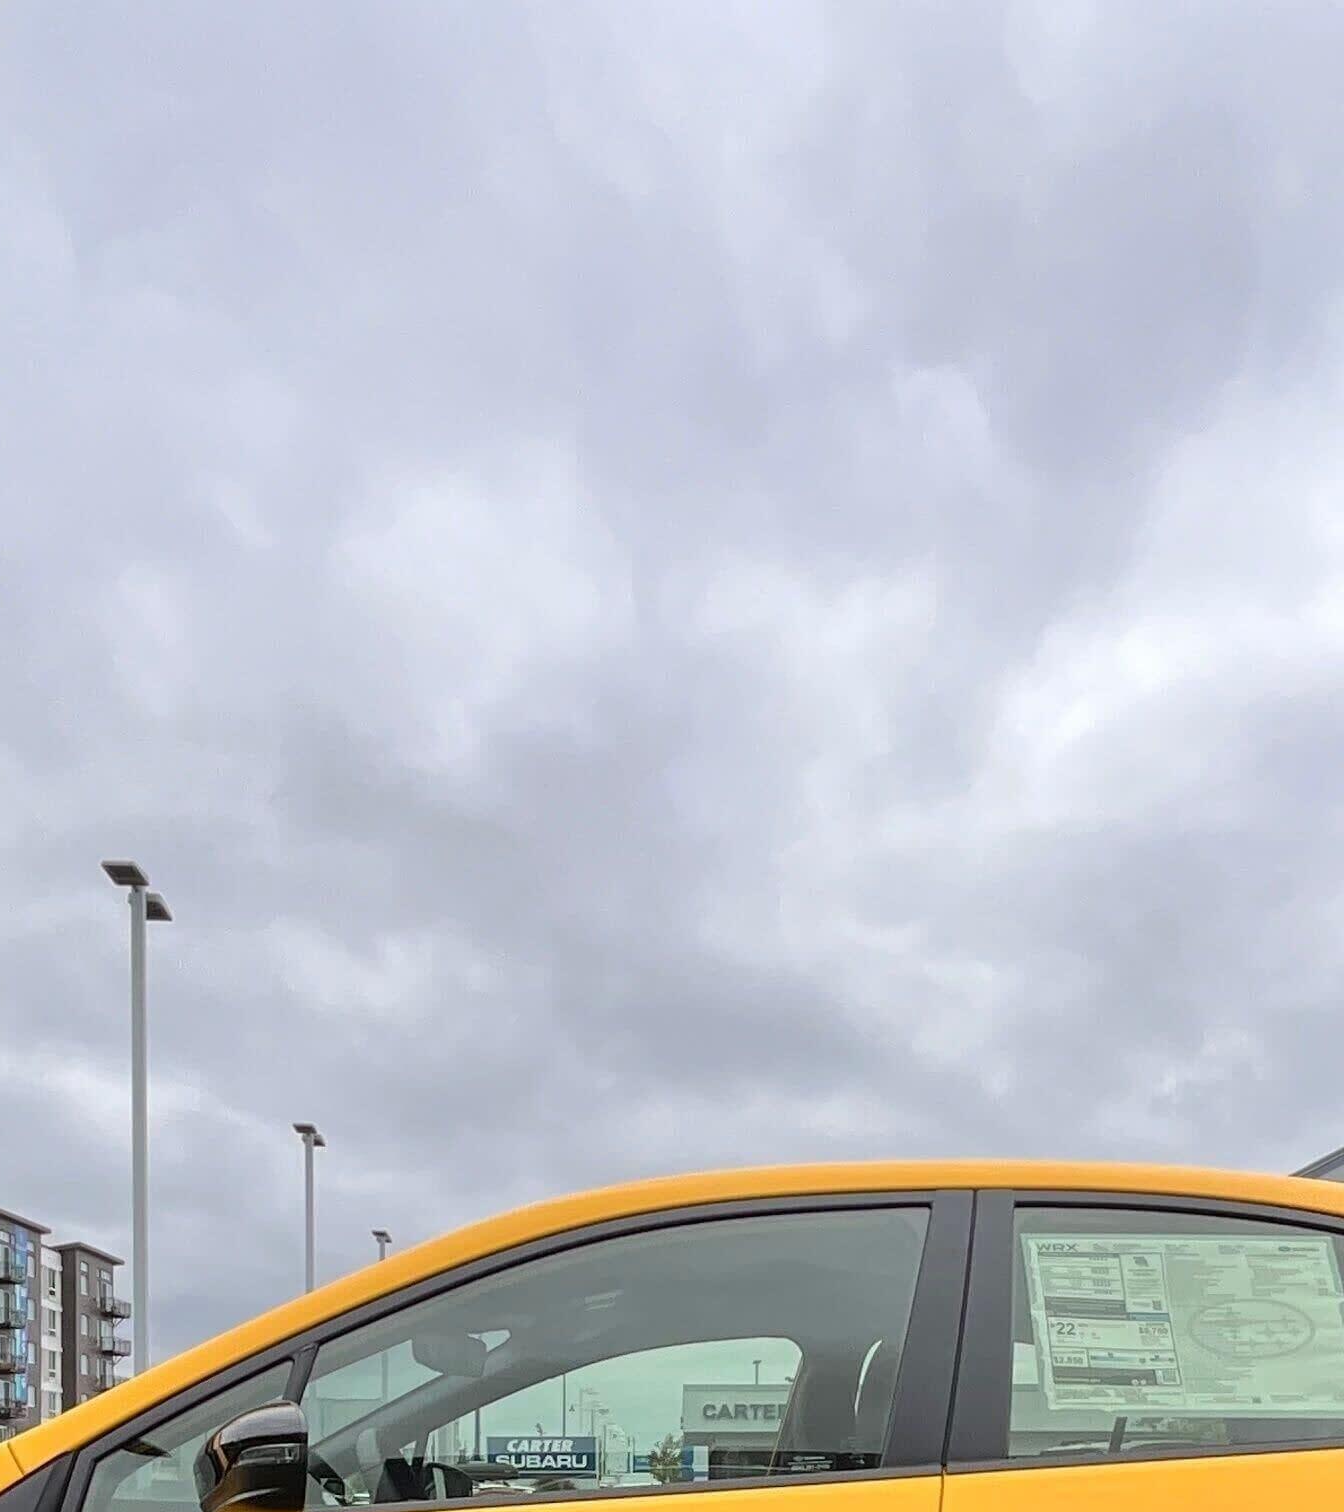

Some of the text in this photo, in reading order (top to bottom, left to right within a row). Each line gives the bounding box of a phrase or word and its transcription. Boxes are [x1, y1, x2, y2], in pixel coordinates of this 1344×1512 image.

[1036, 1242, 1078, 1253] WRX
[1056, 1321, 1077, 1336] 22
[506, 1439, 575, 1453] CARTER
[495, 1454, 588, 1469] SUBARU
